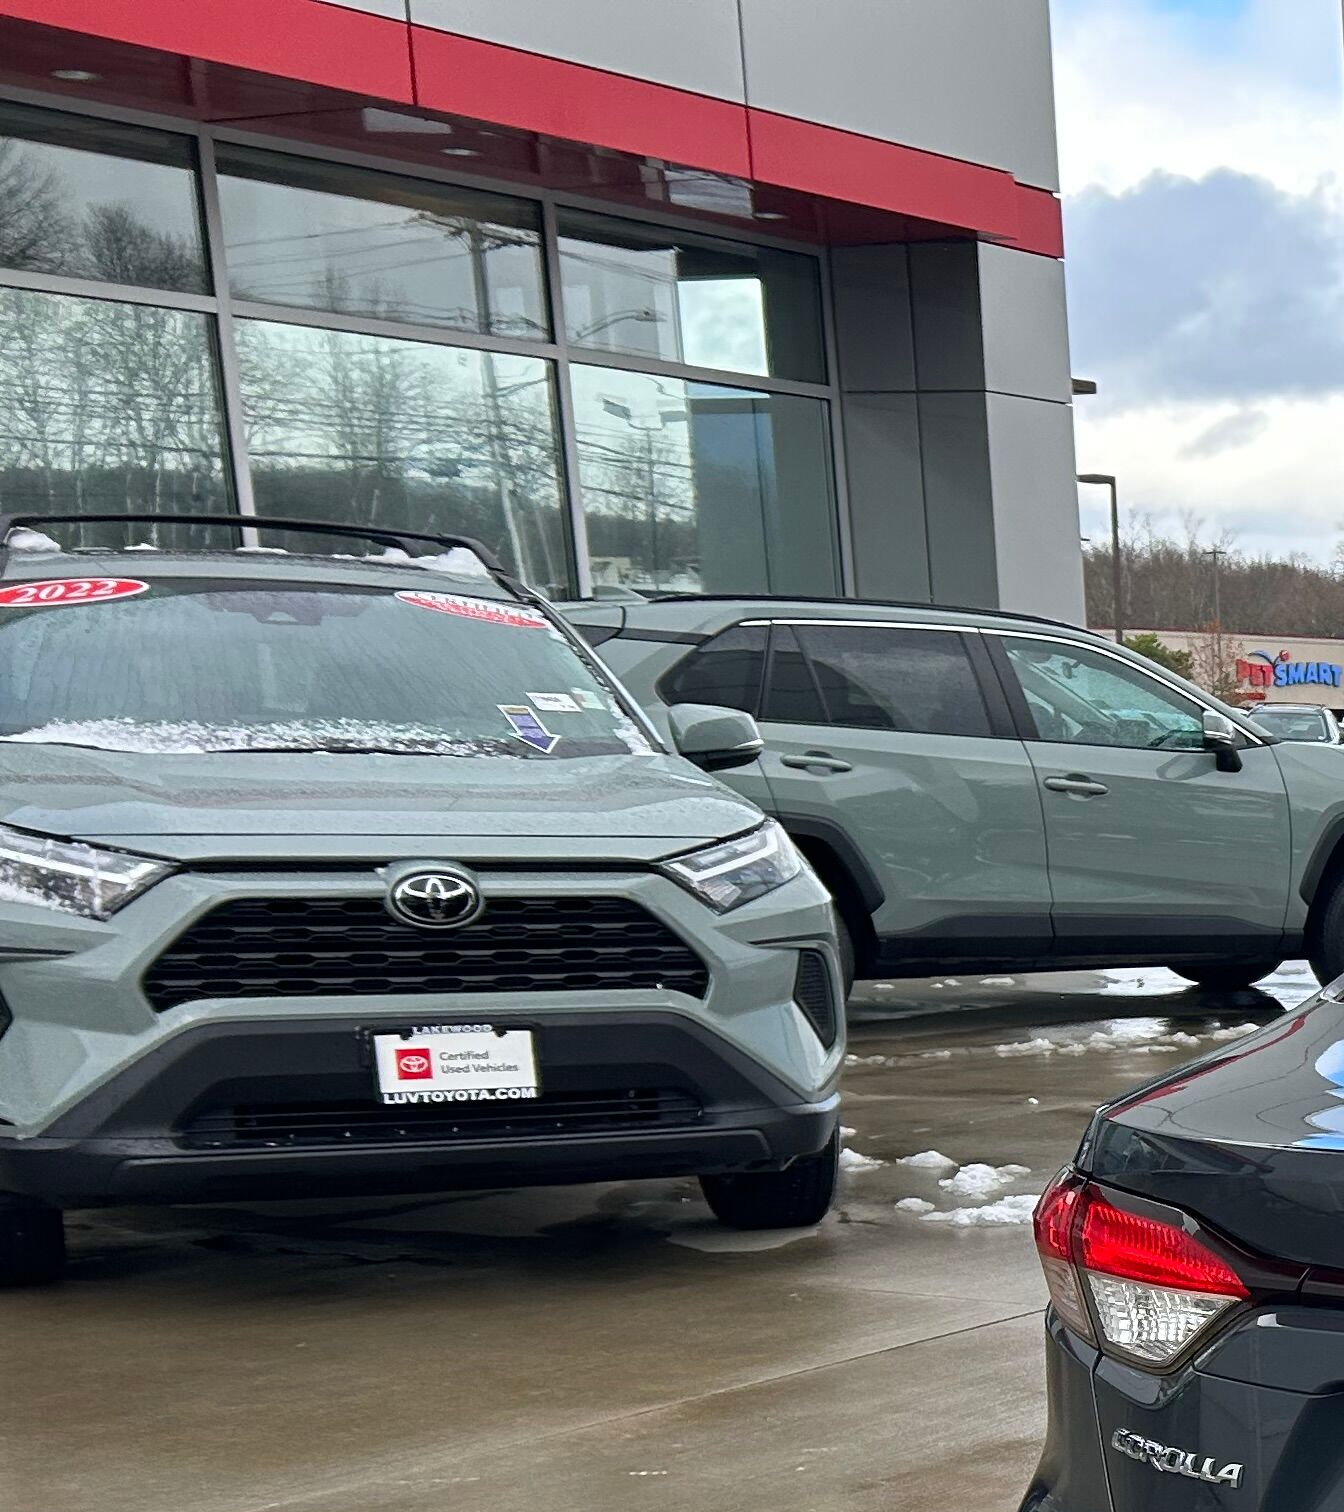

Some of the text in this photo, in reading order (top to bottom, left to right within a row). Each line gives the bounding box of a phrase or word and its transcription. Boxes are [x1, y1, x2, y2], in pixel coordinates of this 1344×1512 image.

[11, 580, 118, 603] 2022
[412, 1024, 494, 1036] LAKEWOOD
[439, 1050, 489, 1061] Certified
[441, 1063, 518, 1074] Used Vehicles
[383, 1087, 537, 1105] LUVTOYOTA.COM
[1111, 1427, 1244, 1488] COROLLA
